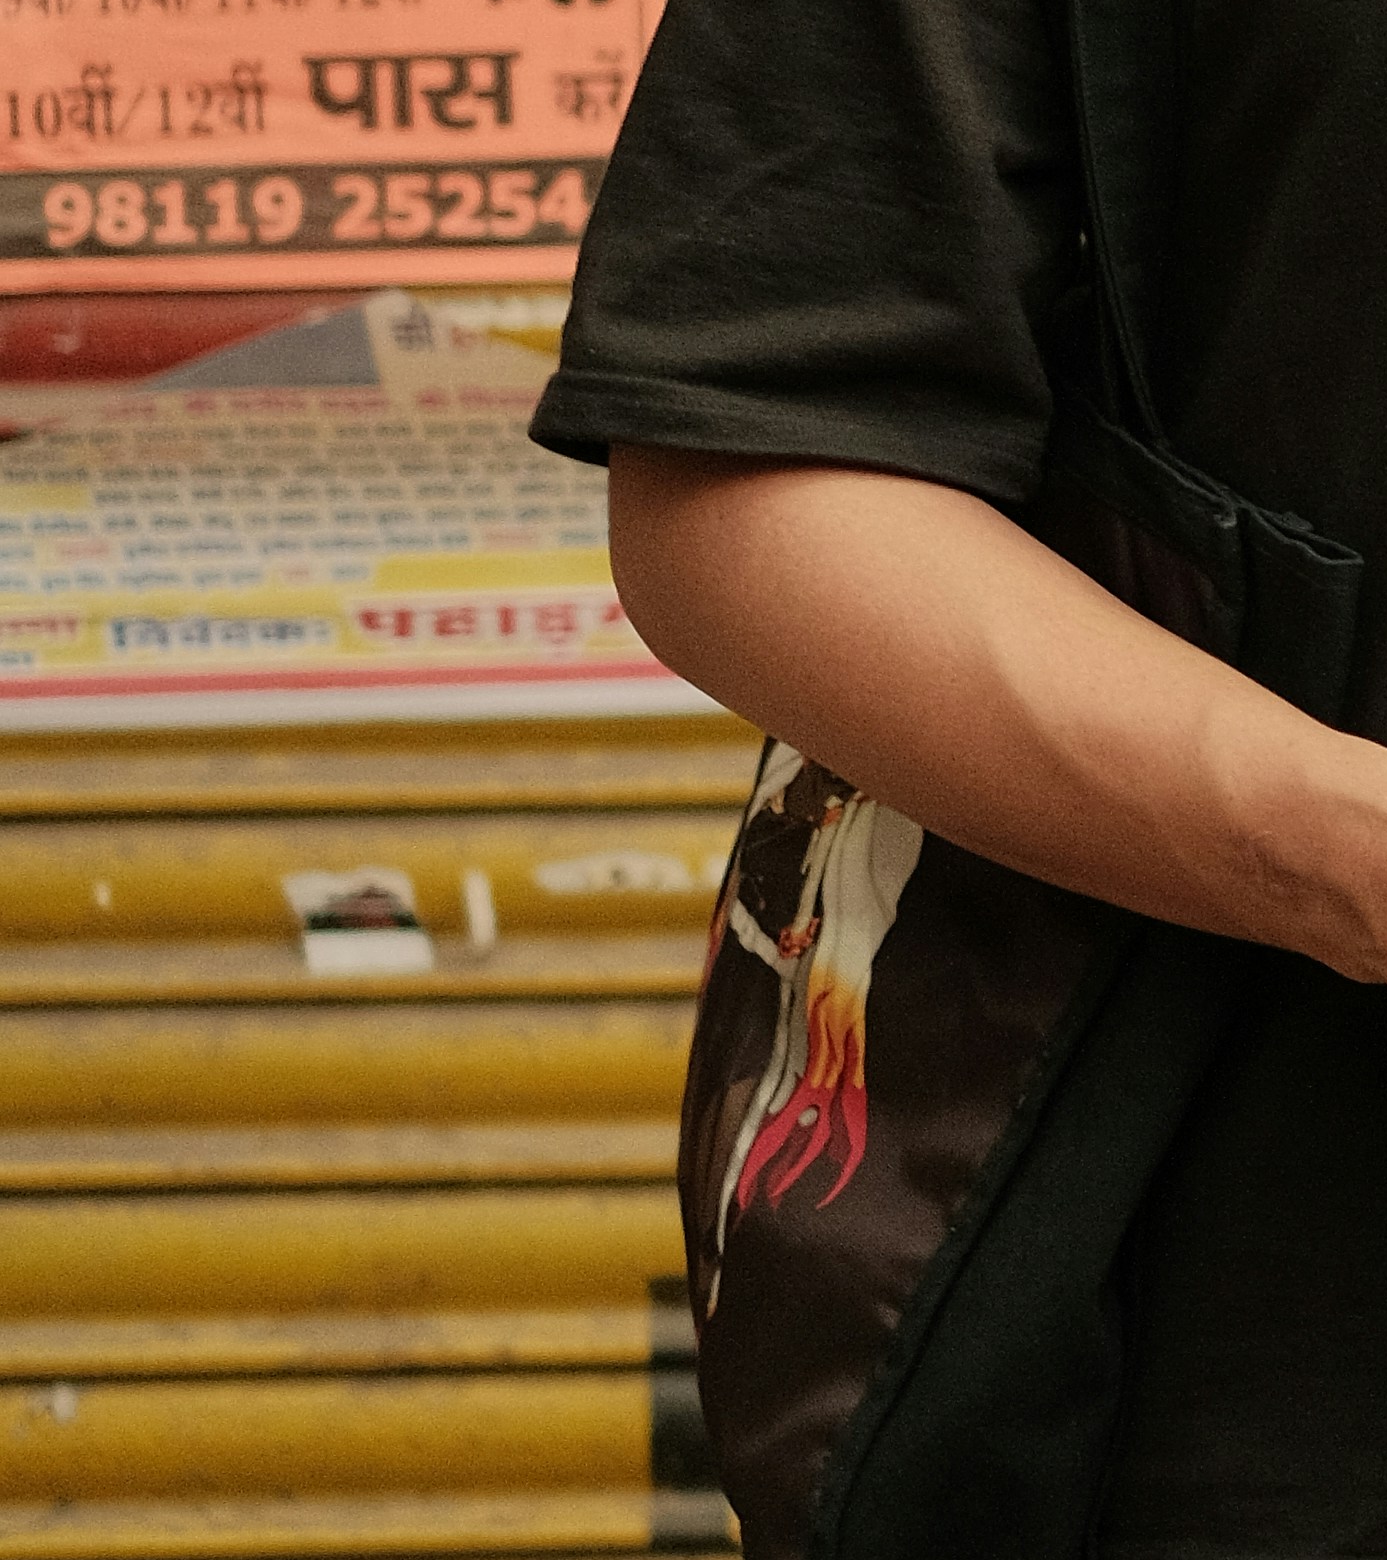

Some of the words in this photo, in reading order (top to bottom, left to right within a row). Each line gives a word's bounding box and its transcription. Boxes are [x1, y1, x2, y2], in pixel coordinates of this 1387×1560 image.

[304, 49, 520, 132] पास
[43, 179, 302, 250] 98119
[332, 168, 590, 241] 25254
